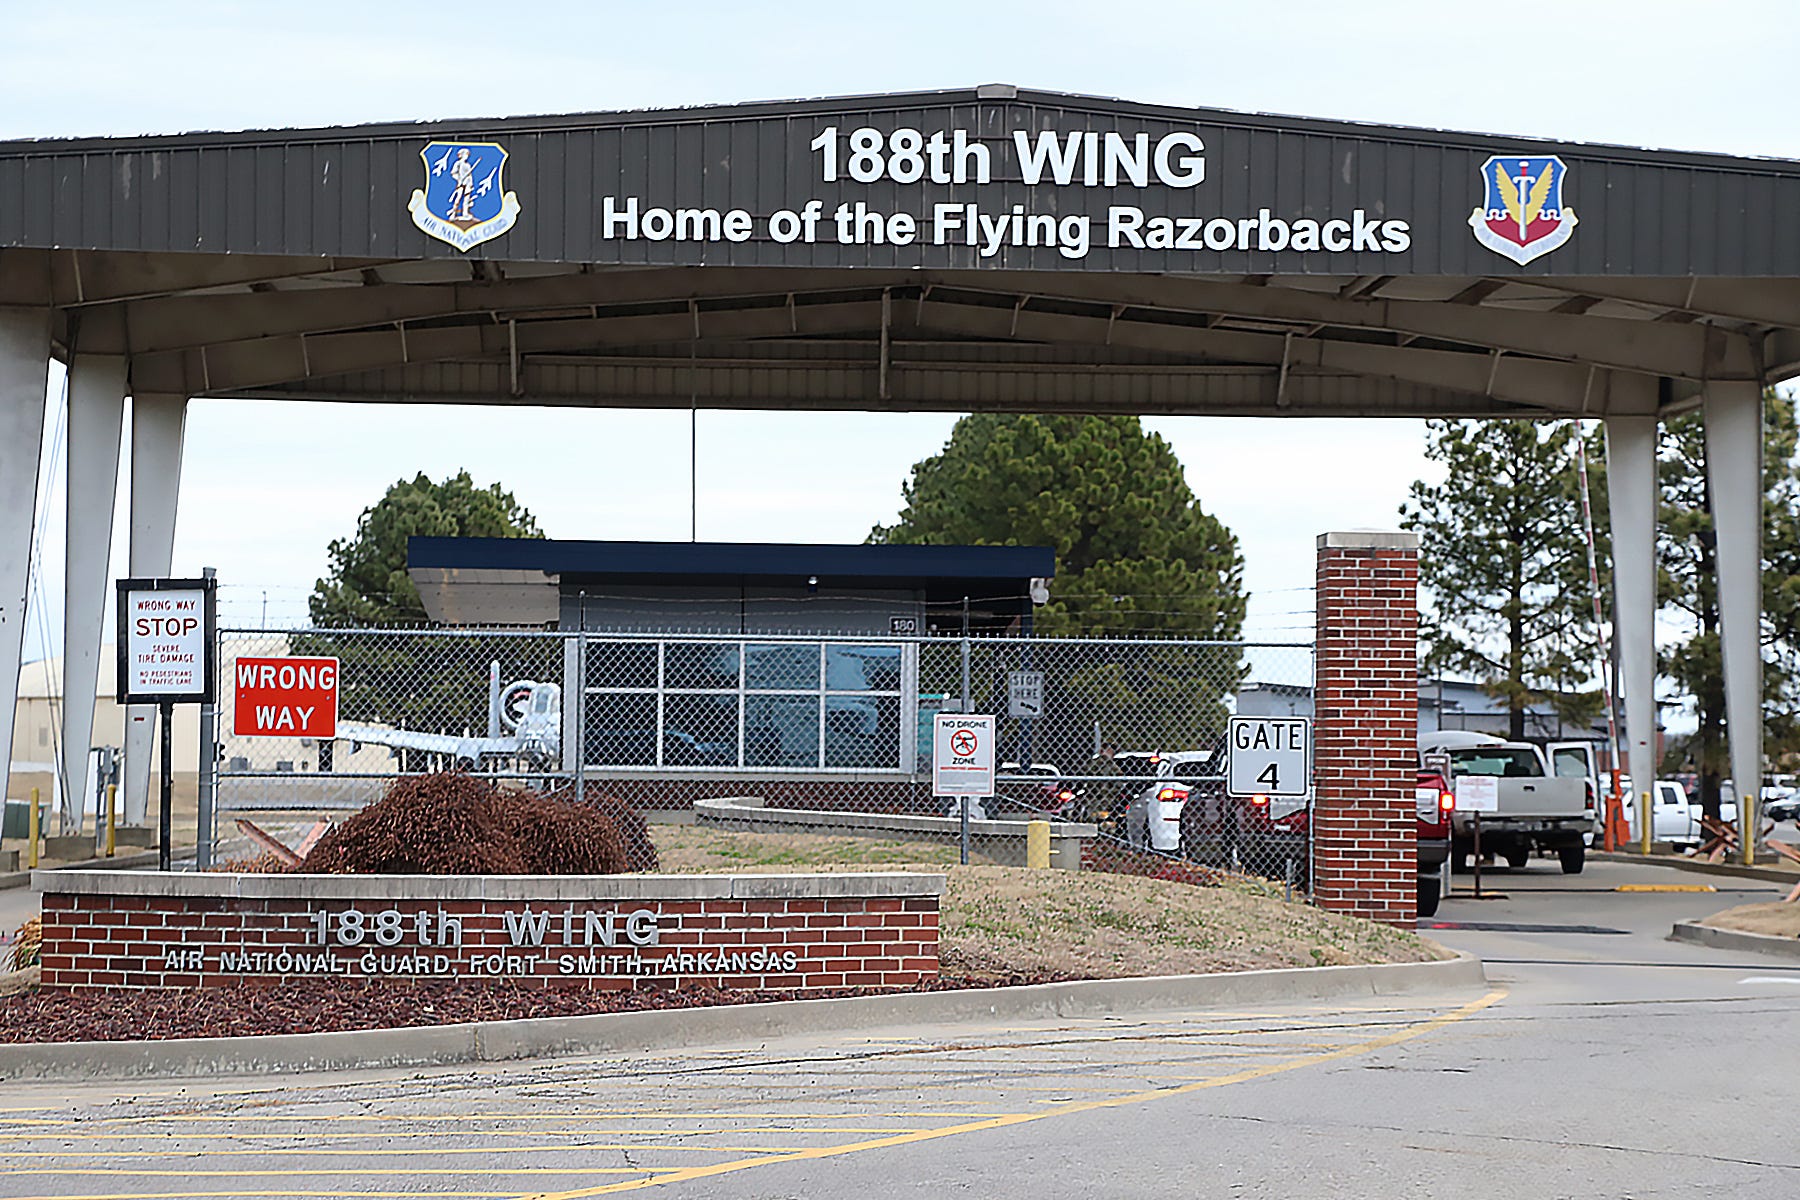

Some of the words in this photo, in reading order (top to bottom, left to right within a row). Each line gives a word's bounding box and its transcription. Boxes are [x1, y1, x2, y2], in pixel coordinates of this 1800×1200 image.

[811, 126, 991, 184] 188th
[1013, 130, 1206, 188] WING
[602, 196, 753, 242] Home
[768, 200, 823, 243] of
[835, 202, 916, 245] the
[933, 203, 1090, 259] Flying
[1108, 206, 1411, 252] Razorbacks
[137, 600, 171, 611] WRONG
[176, 600, 196, 611] WAY
[136, 618, 198, 637] STOP
[893, 620, 915, 631] 180
[138, 654, 156, 663] TIRE
[160, 654, 195, 663] DAMAGE
[152, 644, 180, 653] SEVERE
[237, 664, 335, 690] WRONG
[1013, 674, 1040, 686] STOP
[255, 705, 315, 731] WAY
[942, 721, 955, 729] NO
[957, 721, 987, 729] DRONE
[1235, 723, 1302, 750] GATE
[952, 757, 976, 765] ZONE
[1256, 763, 1280, 790] 4
[310, 909, 463, 947] 188th
[504, 909, 660, 947] WING
[164, 950, 204, 970] AIR
[220, 951, 344, 973] NATIONAL
[360, 953, 458, 976] GUARD,
[470, 954, 540, 976] FORT
[559, 954, 651, 976] SMITH,
[661, 950, 797, 973] ARKANSAS
